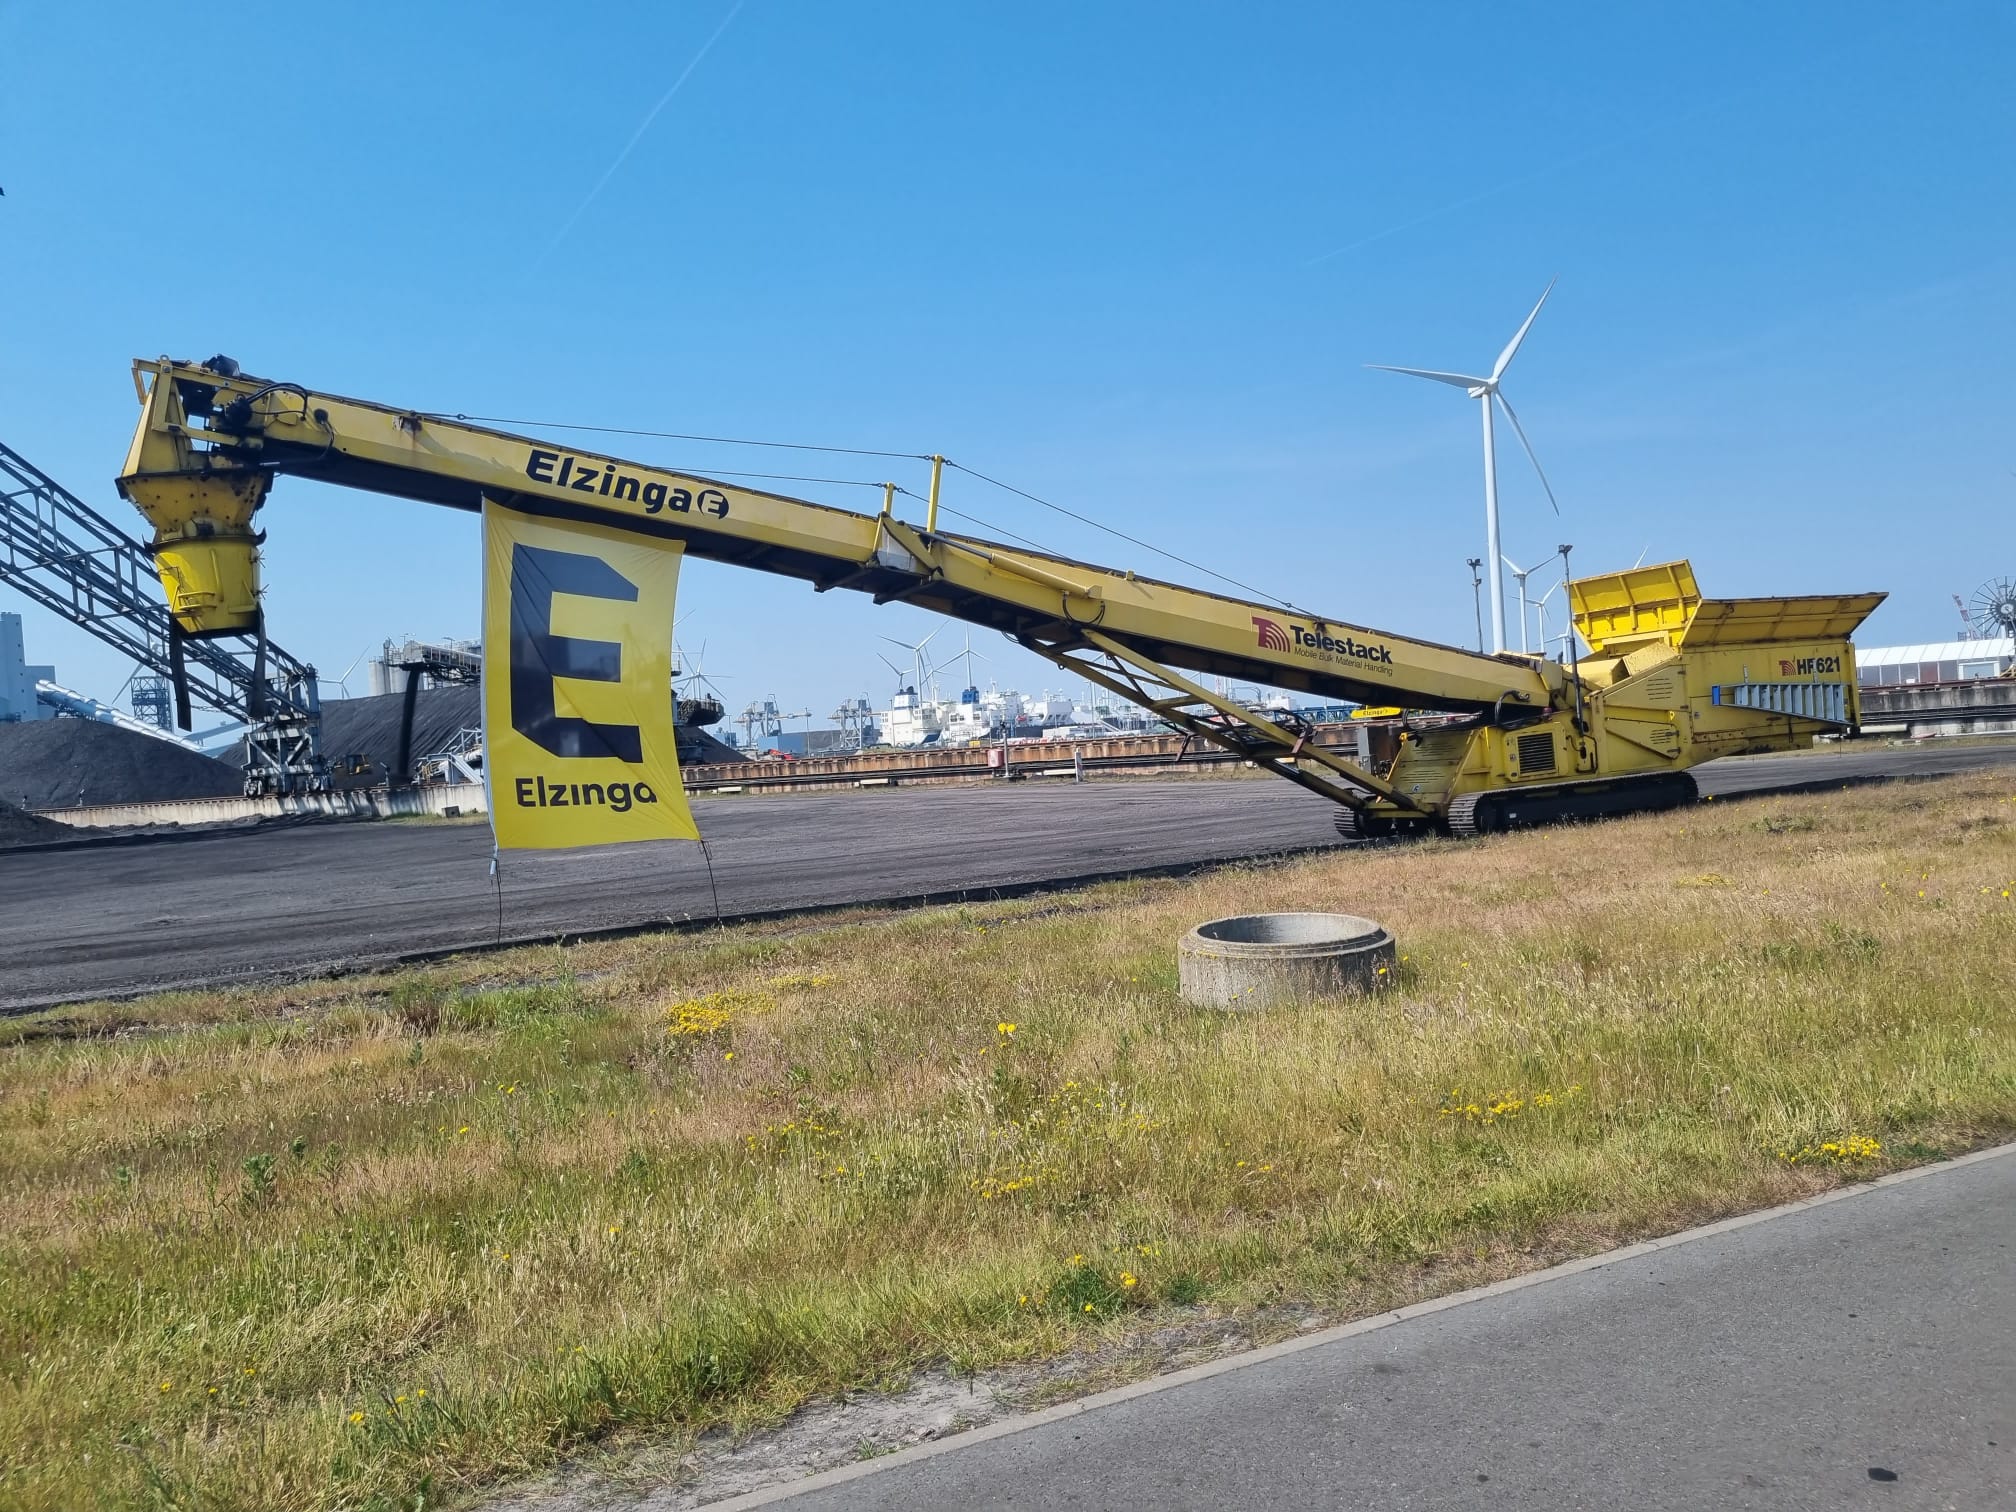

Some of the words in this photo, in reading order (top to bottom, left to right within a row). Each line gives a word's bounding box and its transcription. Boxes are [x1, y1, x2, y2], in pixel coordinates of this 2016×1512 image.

[525, 449, 693, 514] Elzinga
[510, 542, 643, 764] E
[1290, 625, 1393, 665] Telestack
[1294, 647, 1317, 660] Mobile
[1319, 652, 1334, 664] Bulk
[1336, 656, 1363, 669] Material
[1364, 662, 1393, 677] Handling
[1796, 656, 1841, 676] HF621
[515, 775, 658, 812] Elzinga
